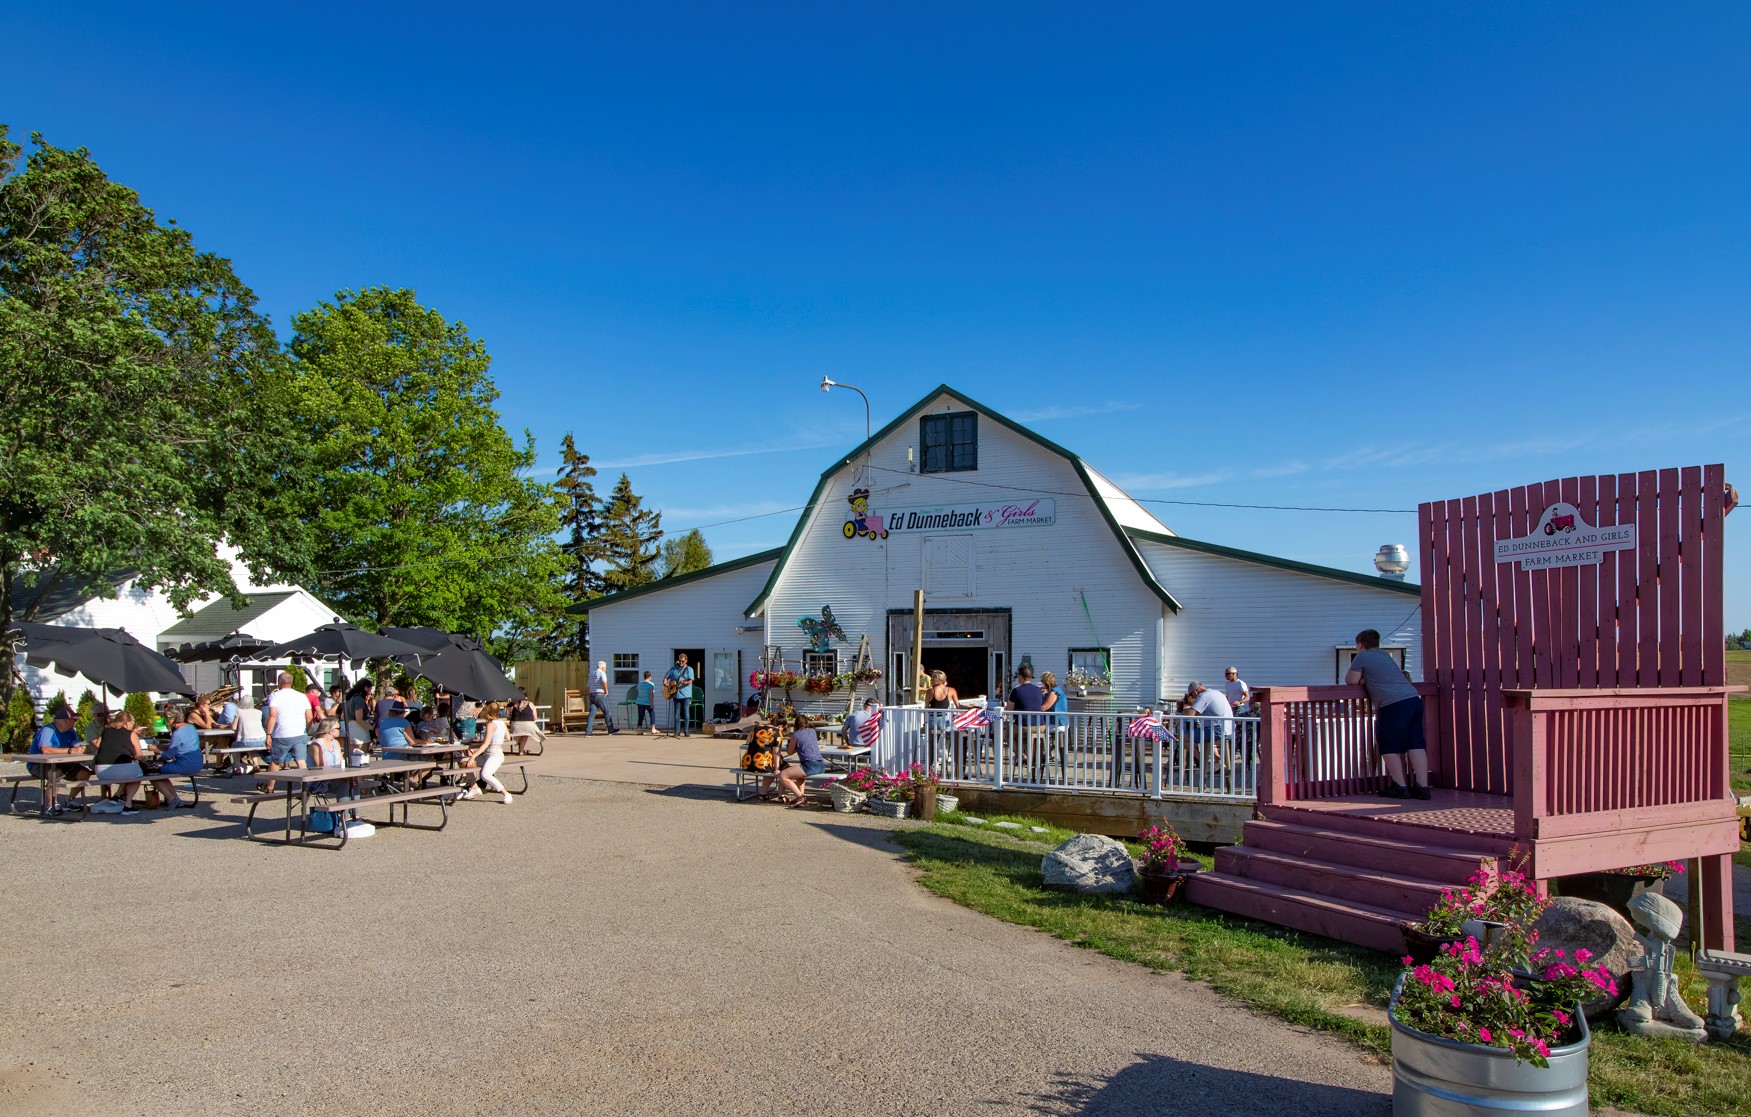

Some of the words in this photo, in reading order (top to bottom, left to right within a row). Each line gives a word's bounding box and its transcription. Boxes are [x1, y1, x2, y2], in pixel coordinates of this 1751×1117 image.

[889, 512, 905, 530] Ed
[907, 508, 983, 529] Dunneback
[984, 509, 1000, 523] &
[996, 500, 1040, 527] Girls
[1026, 516, 1053, 525] MARKET
[1498, 545, 1509, 553] ED
[1512, 537, 1571, 551] DUNNEBACK
[1575, 534, 1598, 544] AND
[1600, 530, 1630, 541] GIRLS
[1525, 556, 1552, 566] FARM
[1555, 551, 1599, 563] MARKET
